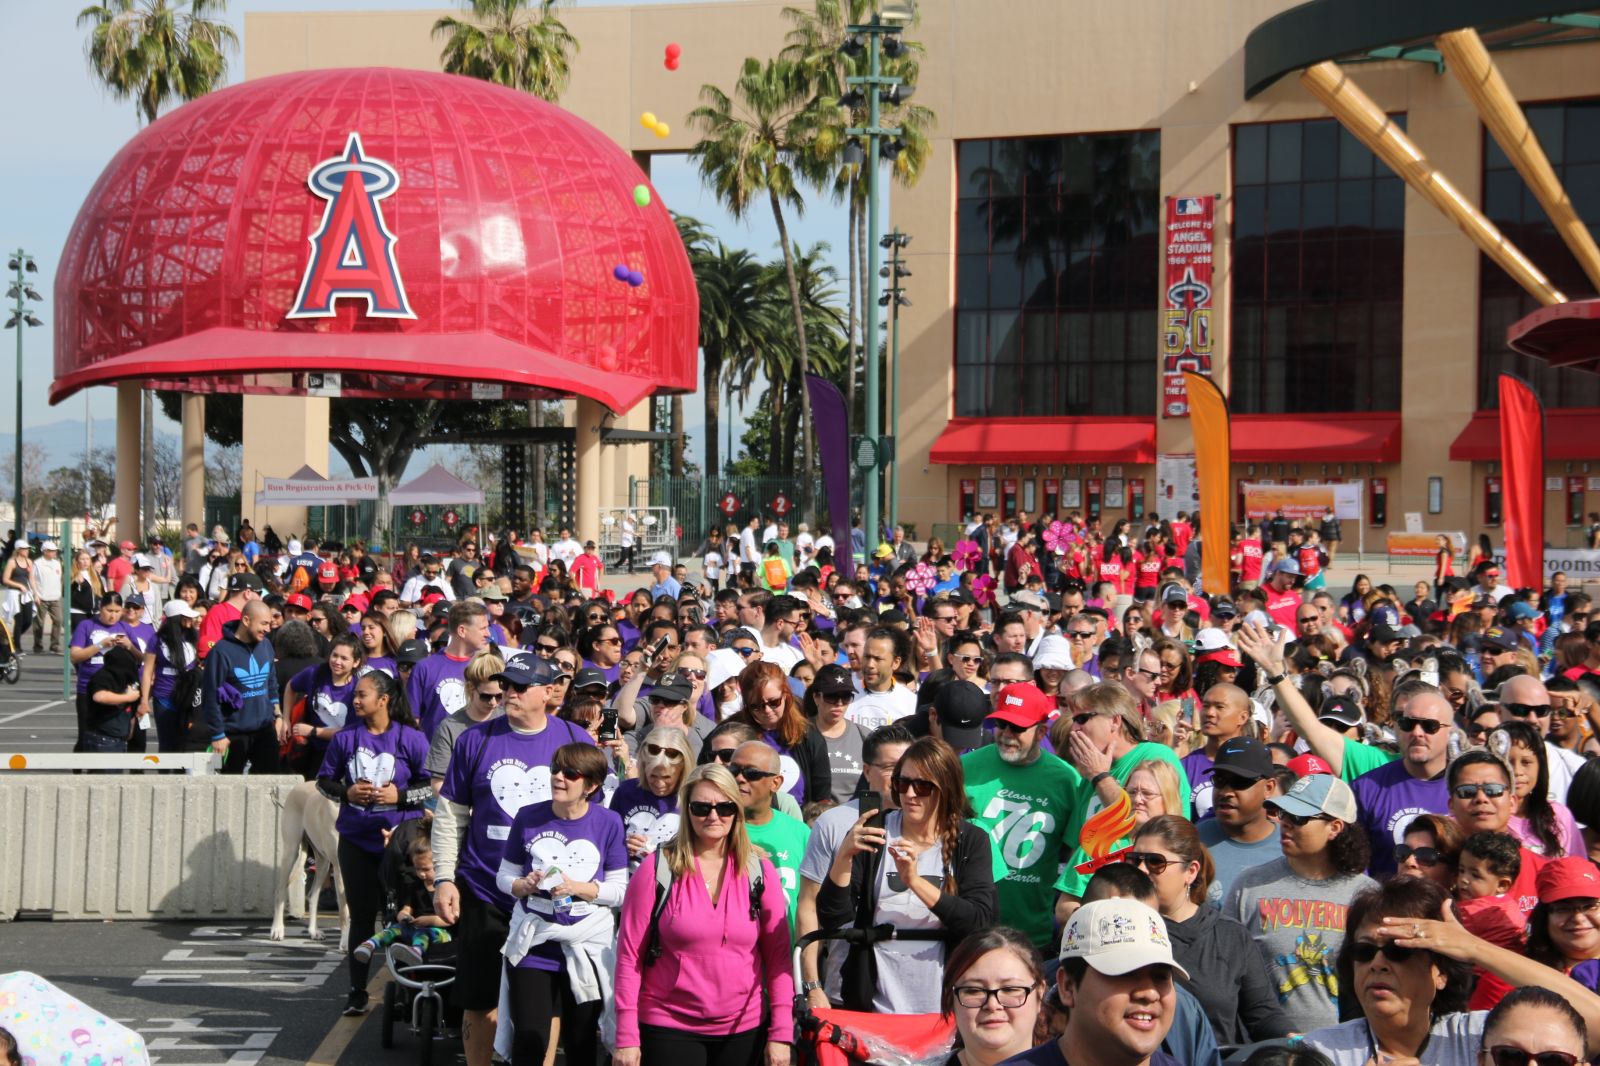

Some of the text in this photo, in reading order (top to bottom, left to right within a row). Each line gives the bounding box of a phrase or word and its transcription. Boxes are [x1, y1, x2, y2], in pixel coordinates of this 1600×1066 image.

[1168, 220, 1213, 231] WELCOME TO
[1172, 232, 1207, 243] ANGEL
[1167, 243, 1212, 255] STADIUM
[1164, 308, 1212, 356] 50
[267, 484, 284, 492] Run
[285, 483, 335, 493] Registration
[345, 483, 376, 493] Pick-Up
[725, 497, 735, 512] 2
[776, 497, 786, 512] 2
[414, 512, 421, 523] 2
[447, 512, 454, 523] 2
[1036, 797, 1049, 808] of
[982, 796, 1056, 869] 76
